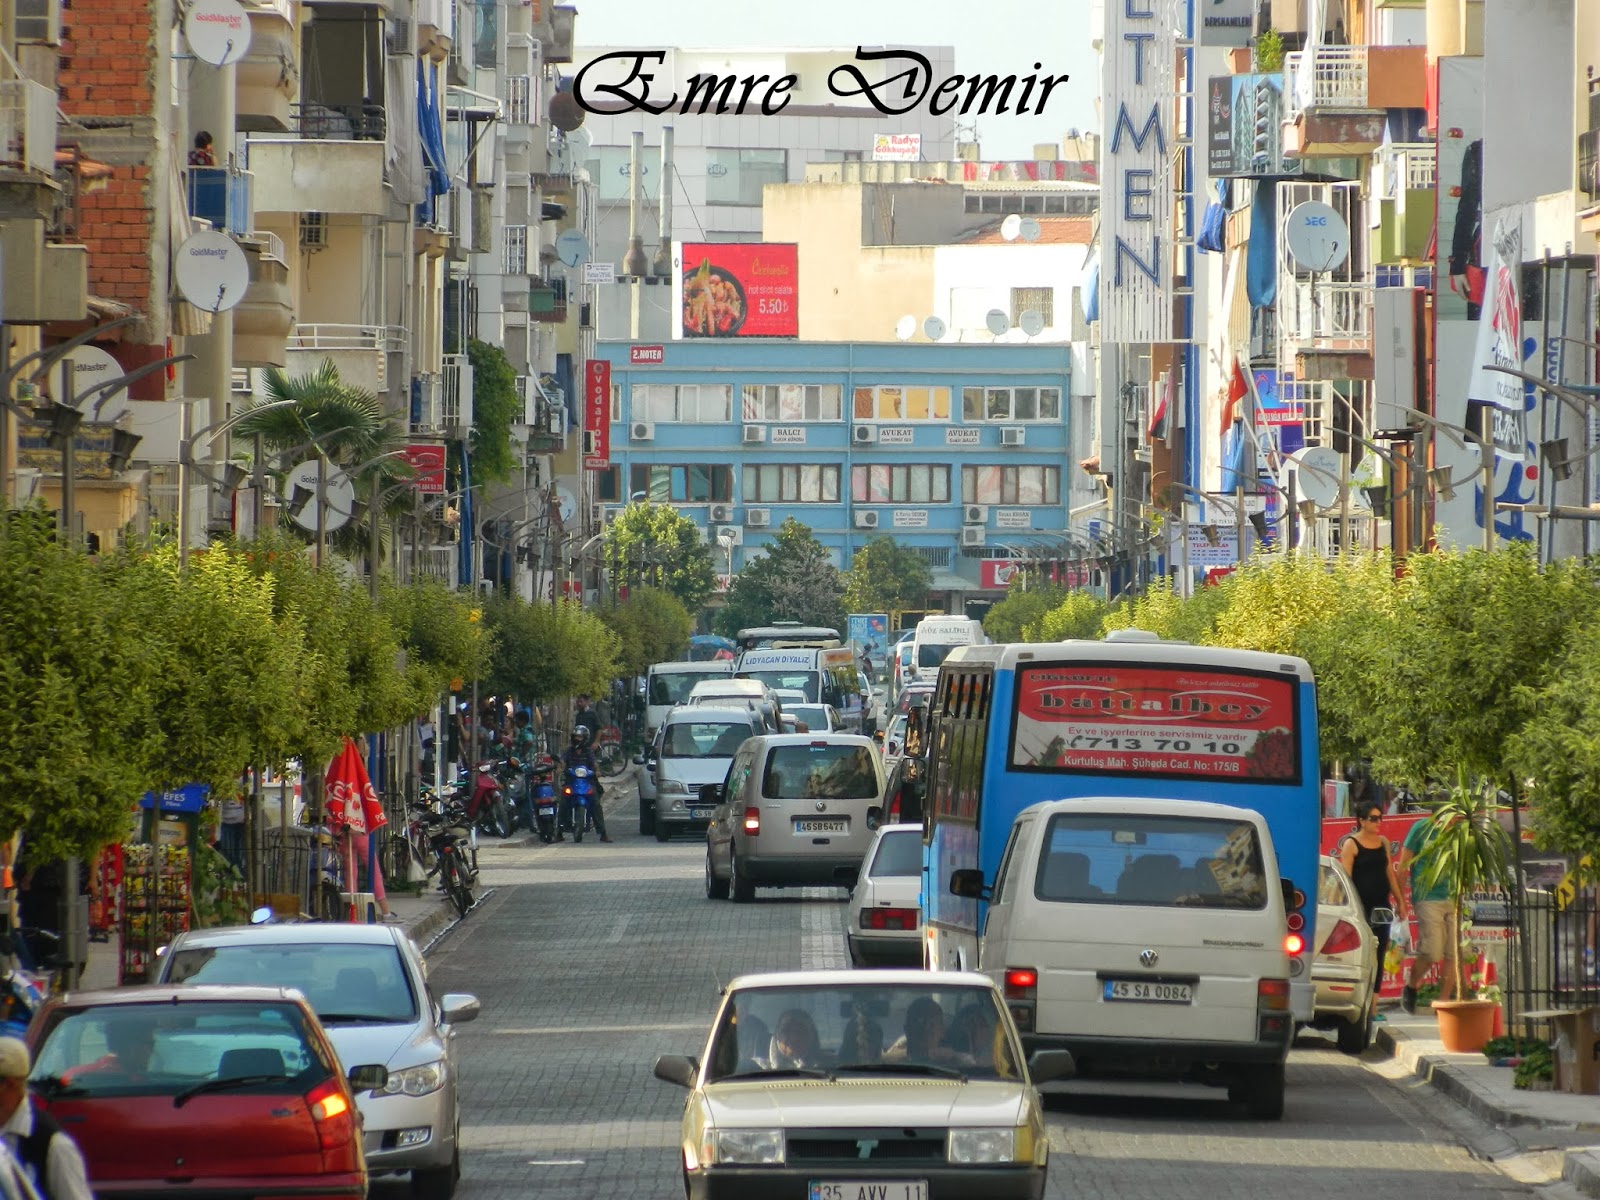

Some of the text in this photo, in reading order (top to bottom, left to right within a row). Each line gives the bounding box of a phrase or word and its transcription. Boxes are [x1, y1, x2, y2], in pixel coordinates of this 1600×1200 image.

[891, 135, 919, 146] Radyo
[875, 145, 918, 154] Gökkuşağı
[1305, 216, 1326, 226] SEG
[632, 349, 662, 359] 2.NOTER
[594, 375, 602, 457] vodafone
[1040, 693, 1271, 719] battalbey
[1068, 726, 1081, 735] Ev
[1100, 727, 1156, 737] işyerlerine
[1159, 730, 1213, 740] servisimiz
[1216, 732, 1247, 741] vardır
[1085, 737, 1240, 754] 713 70 10
[1064, 755, 1240, 772] Kurtuluş Mah. Şüheda Cad. No: 175/B
[163, 792, 186, 802] EFES
[1113, 984, 1187, 999] 45 SA 0084
[823, 1185, 842, 1200] 35
[905, 1185, 920, 1200] 11
